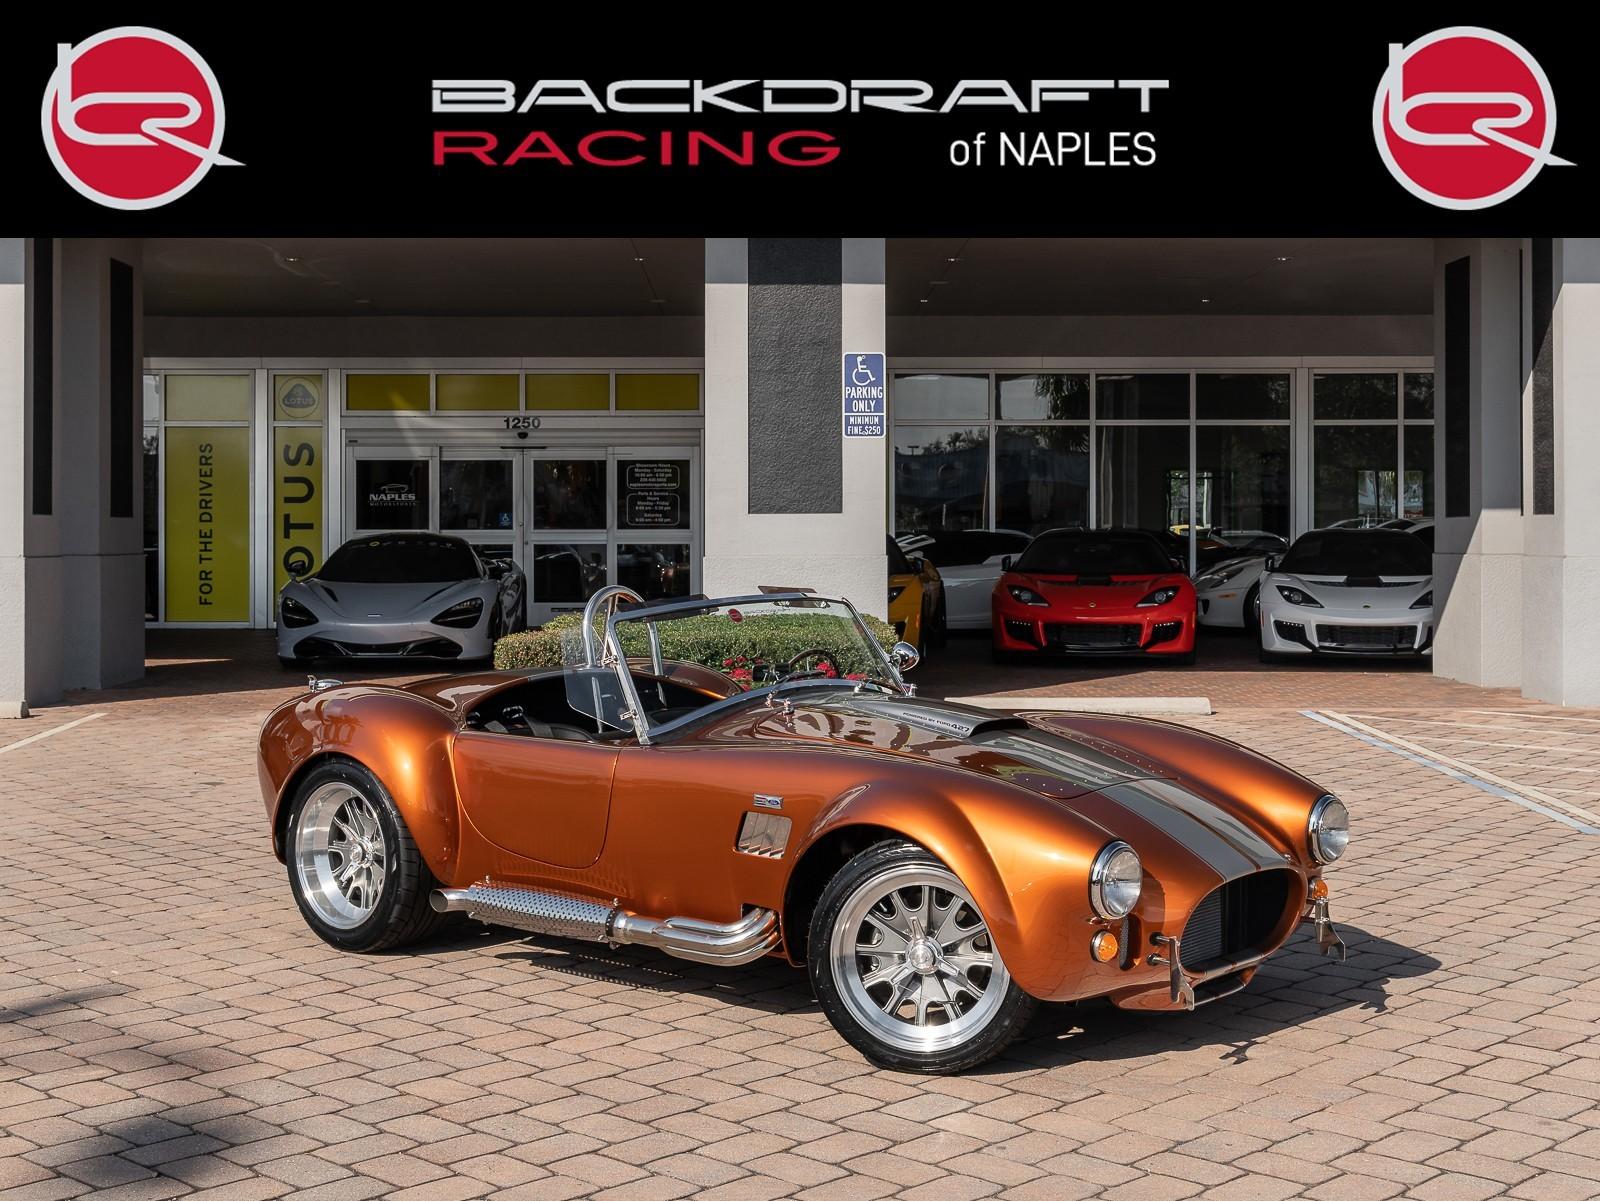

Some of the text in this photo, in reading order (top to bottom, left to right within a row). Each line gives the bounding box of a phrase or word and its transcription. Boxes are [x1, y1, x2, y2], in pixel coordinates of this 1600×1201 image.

[845, 386, 883, 398] PARKING
[852, 400, 876, 412] ONLY
[504, 416, 541, 429] 1250
[849, 416, 879, 424] MINIMUM
[848, 426, 880, 435] FINE $250
[283, 442, 314, 577] OTUS
[198, 442, 213, 606] FOR THE DRIVERS
[951, 723, 970, 732] 427
